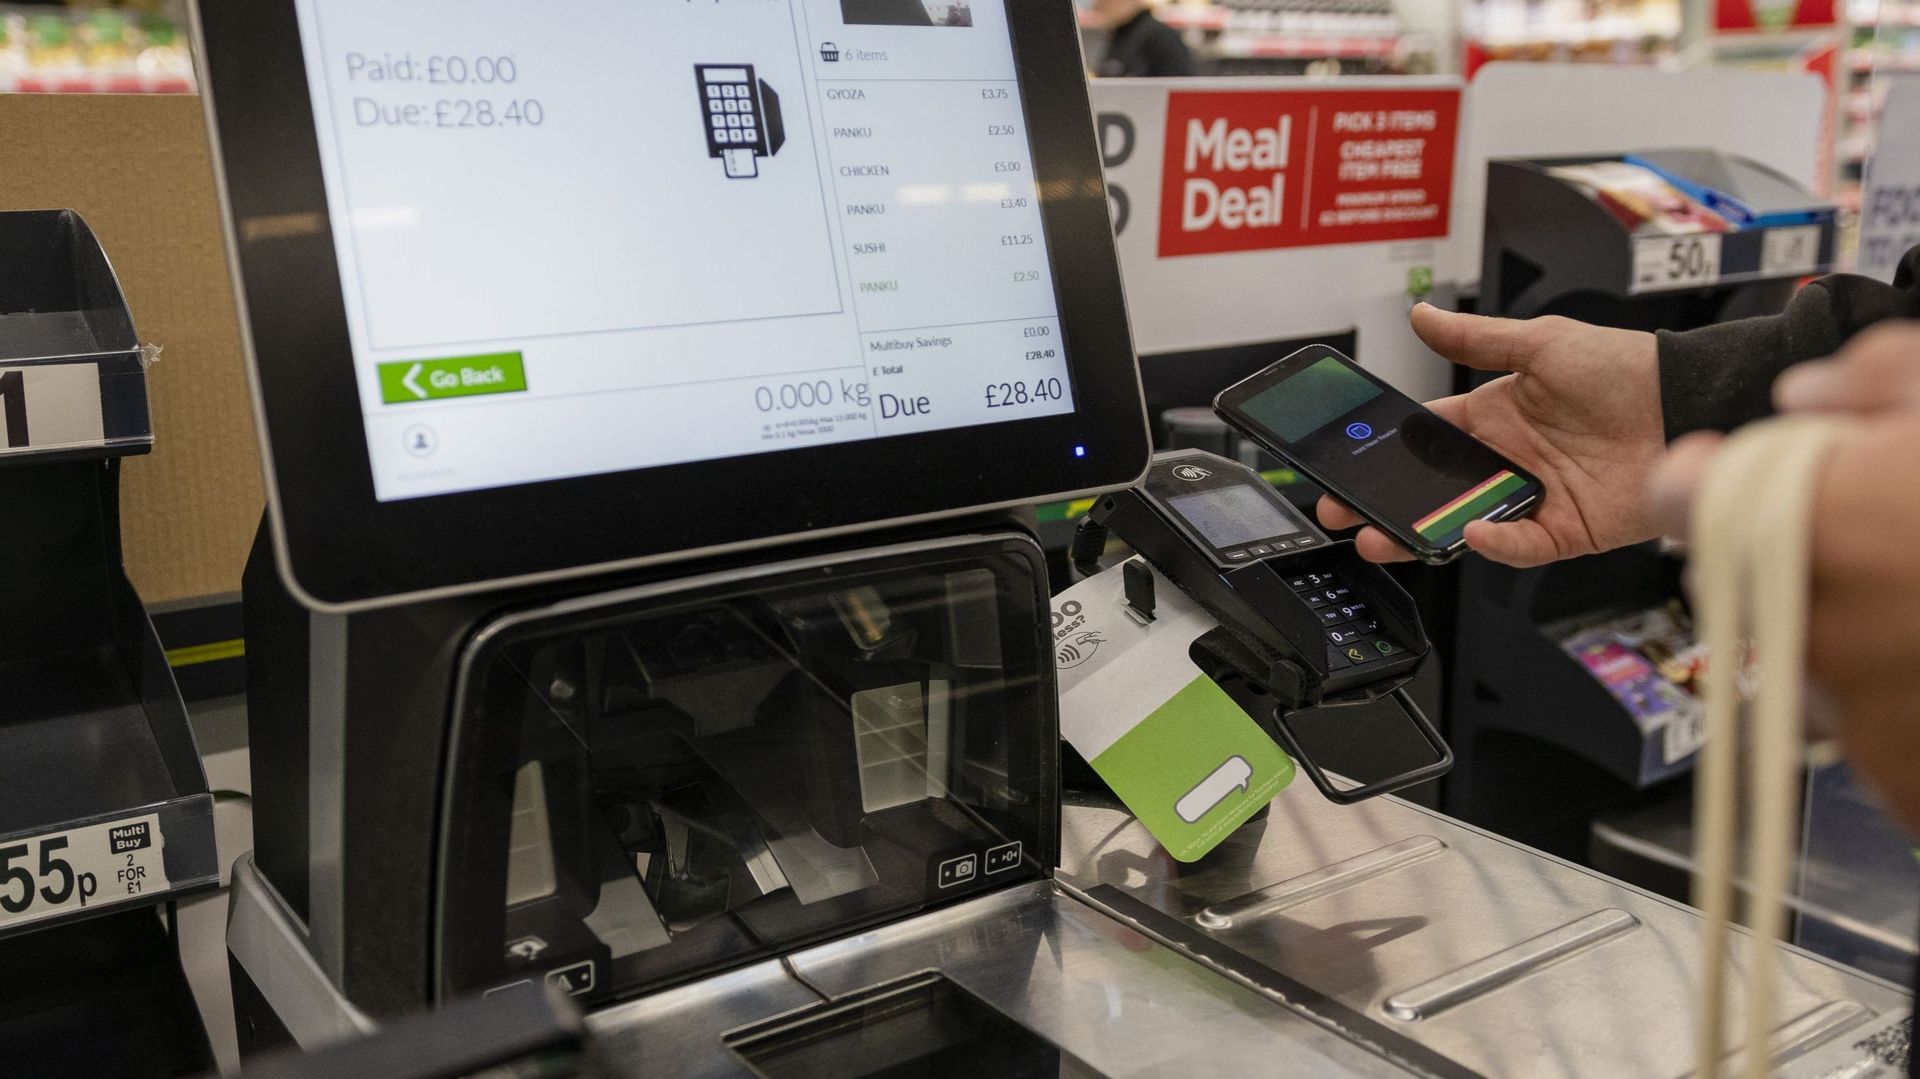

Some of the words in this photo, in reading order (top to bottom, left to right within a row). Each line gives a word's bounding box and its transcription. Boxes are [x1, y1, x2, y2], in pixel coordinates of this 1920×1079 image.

[845, 50, 853, 61] 6
[856, 49, 888, 61] items
[827, 89, 866, 100] GYOZA
[982, 88, 1008, 100] £3.75
[1333, 112, 1371, 132] PICK
[1390, 110, 1437, 131] ITEMS
[833, 127, 872, 138] PANKU
[988, 125, 1014, 136] £2.50
[1184, 113, 1292, 173] Meal
[1340, 139, 1426, 160] CHEAPEST
[840, 165, 890, 177] CHICKEN
[994, 161, 1021, 172] £5.00
[1339, 161, 1377, 180] ITEM
[1381, 159, 1422, 179] FREE
[1001, 198, 1027, 209] £3.40
[1182, 172, 1285, 231] Deal
[846, 204, 885, 215] PANKU
[1001, 235, 1033, 246] £11.25
[853, 242, 886, 254] SUSHI
[1013, 271, 1040, 282] £2.50
[860, 280, 899, 292] PANKU
[1023, 327, 1050, 338] £0.00
[870, 340, 915, 352] Multibuy
[916, 337, 953, 351] Savings
[1025, 349, 1056, 361] £28.40
[430, 369, 458, 389] Go
[460, 364, 507, 387] Back
[873, 367, 880, 376] £
[881, 365, 904, 375] Total
[755, 380, 833, 412] 0.000
[840, 378, 872, 407] kg
[985, 377, 1063, 408] £28.40
[879, 393, 931, 419] Due
[1309, 574, 1320, 584] 3
[1326, 590, 1337, 599] 6
[1342, 606, 1353, 617] 9
[1331, 631, 1343, 642] 0
[113, 825, 145, 840] Multi
[116, 838, 141, 850] Buy
[126, 853, 134, 867] 2
[117, 865, 146, 883] FOR
[127, 880, 141, 894] £1
